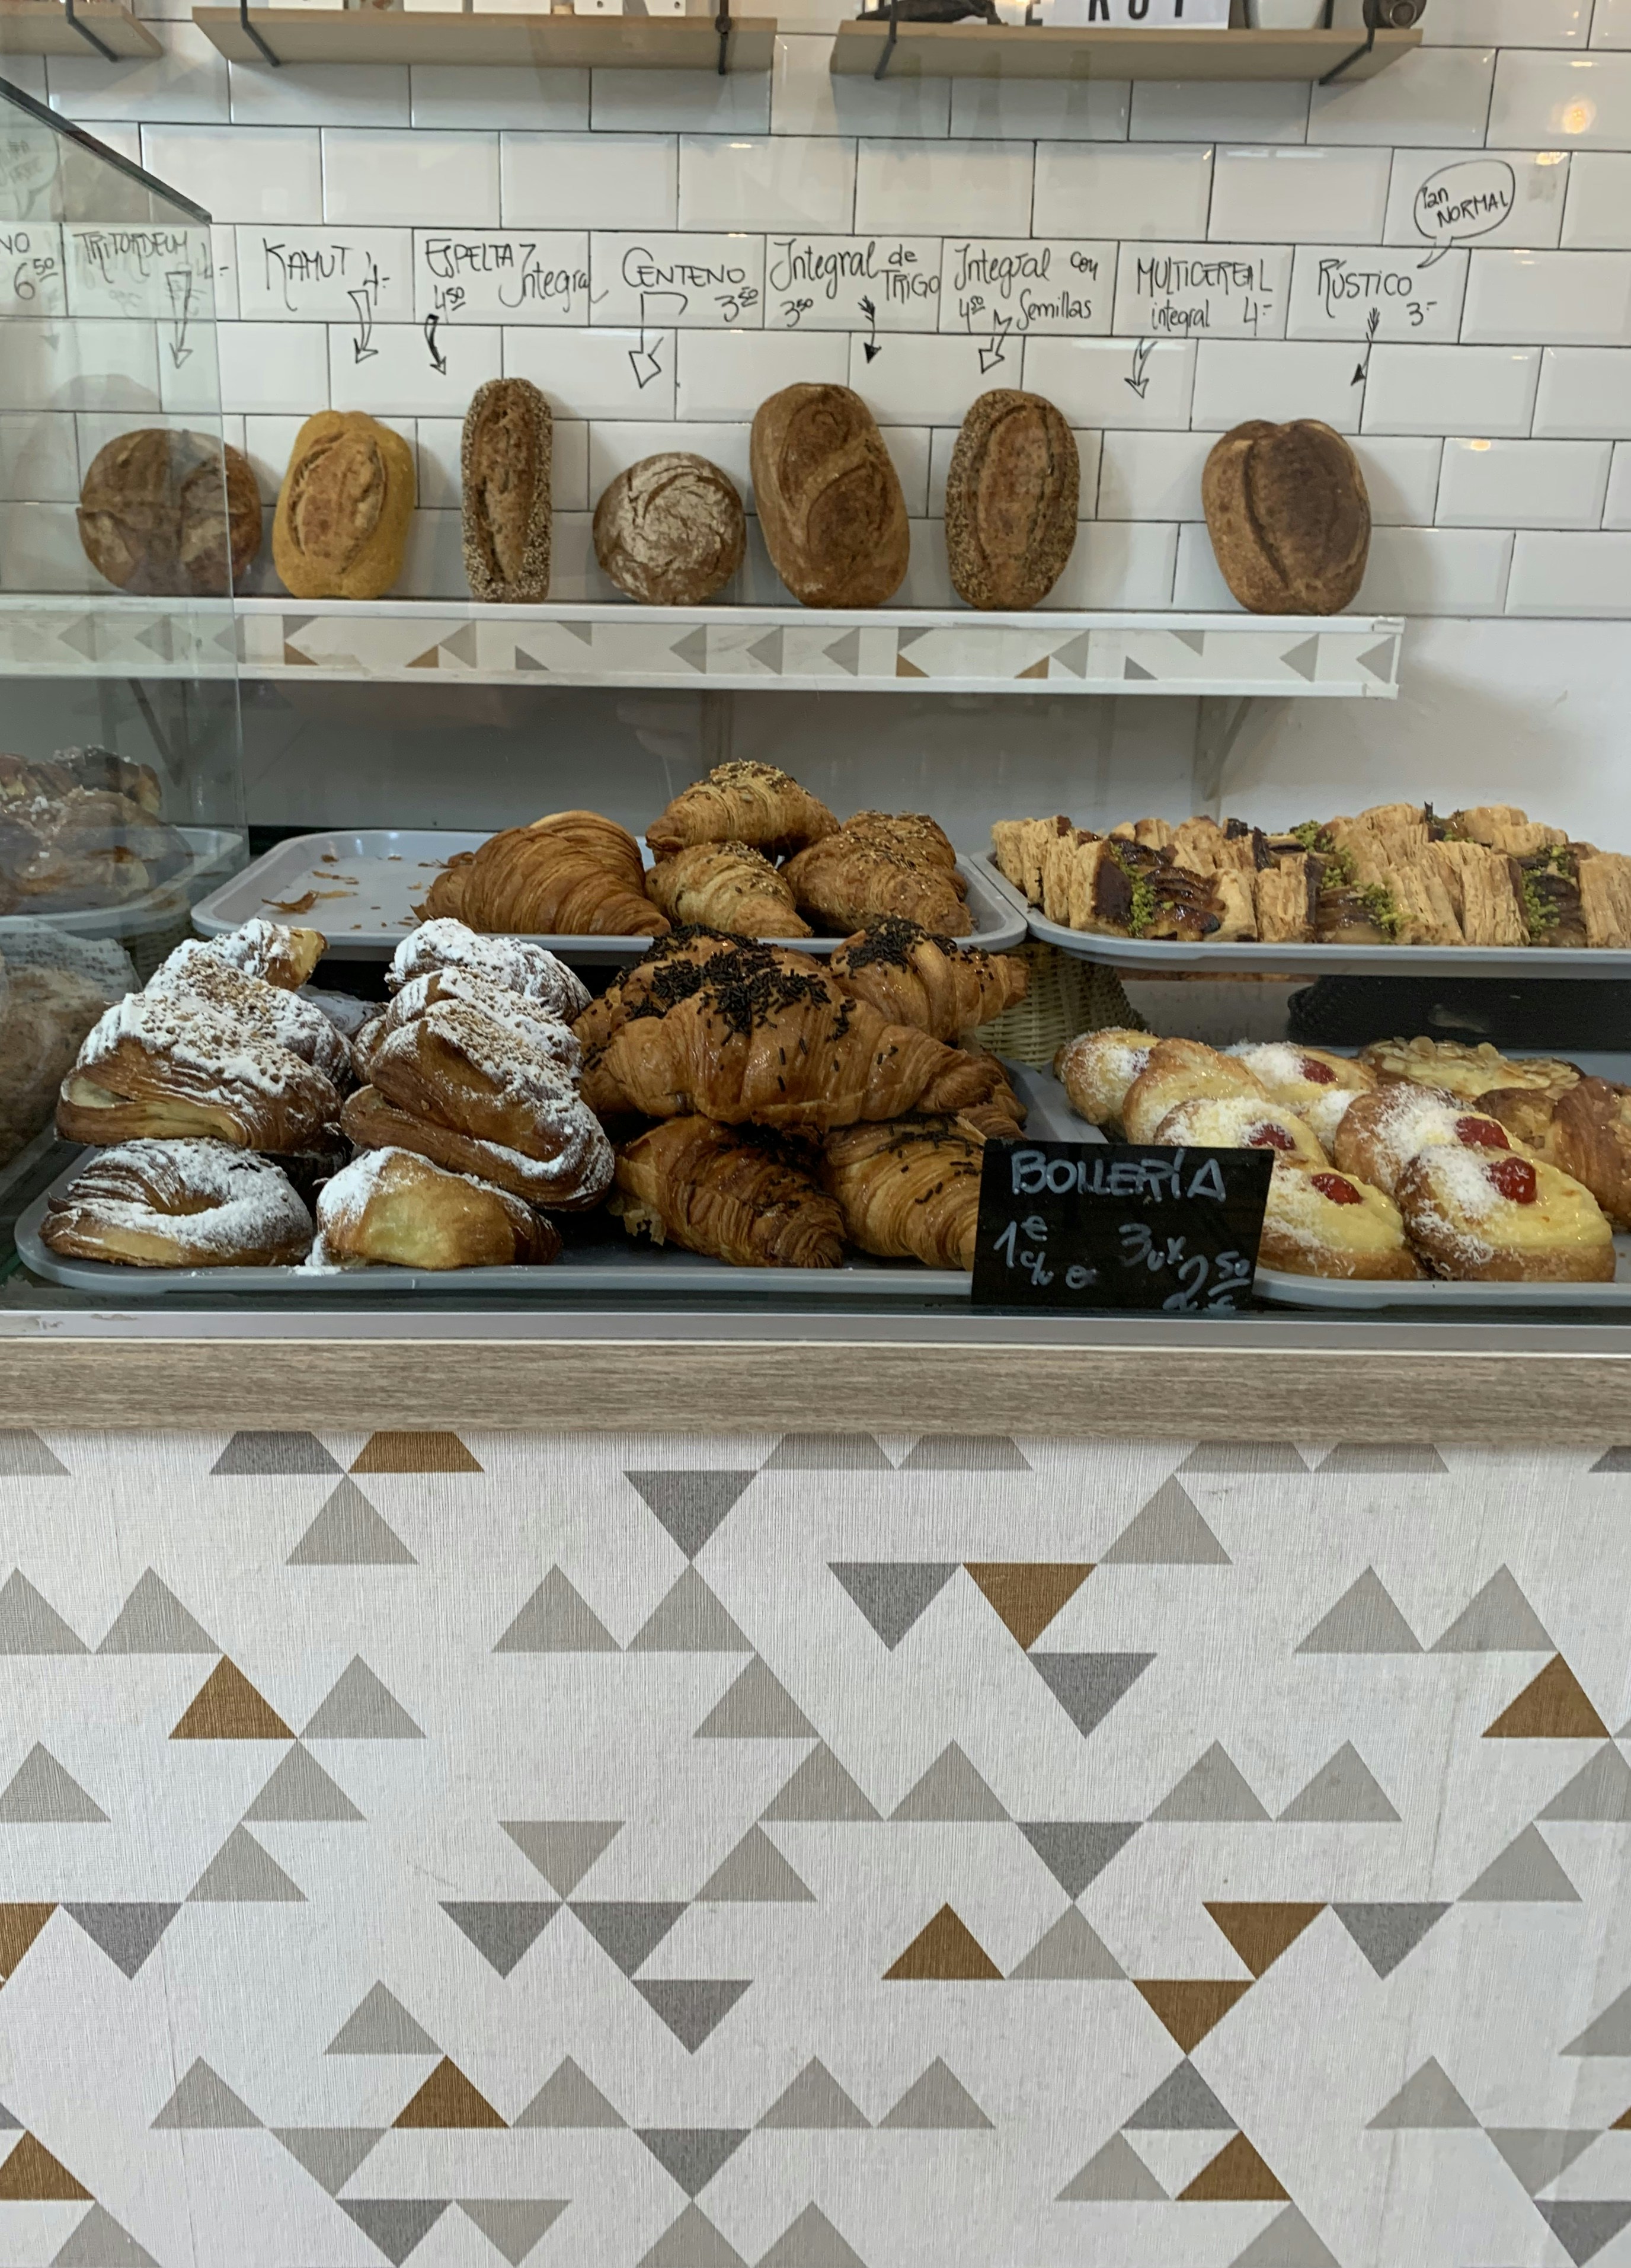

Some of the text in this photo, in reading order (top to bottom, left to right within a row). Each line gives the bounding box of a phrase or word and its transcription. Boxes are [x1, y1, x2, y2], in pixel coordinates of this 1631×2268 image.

[1422, 186, 1448, 209] Pan
[1437, 190, 1508, 228] NORMAL
[263, 238, 354, 312] KAMUT
[425, 238, 609, 313] ESPELTA Integral
[622, 247, 746, 288] CENTENO
[770, 238, 918, 299] Integral de
[955, 244, 1050, 299] Integral
[1137, 257, 1273, 298] MULTICEREAL
[1152, 299, 1210, 338] integral
[1011, 1148, 1226, 1203] BOLLERÍA
